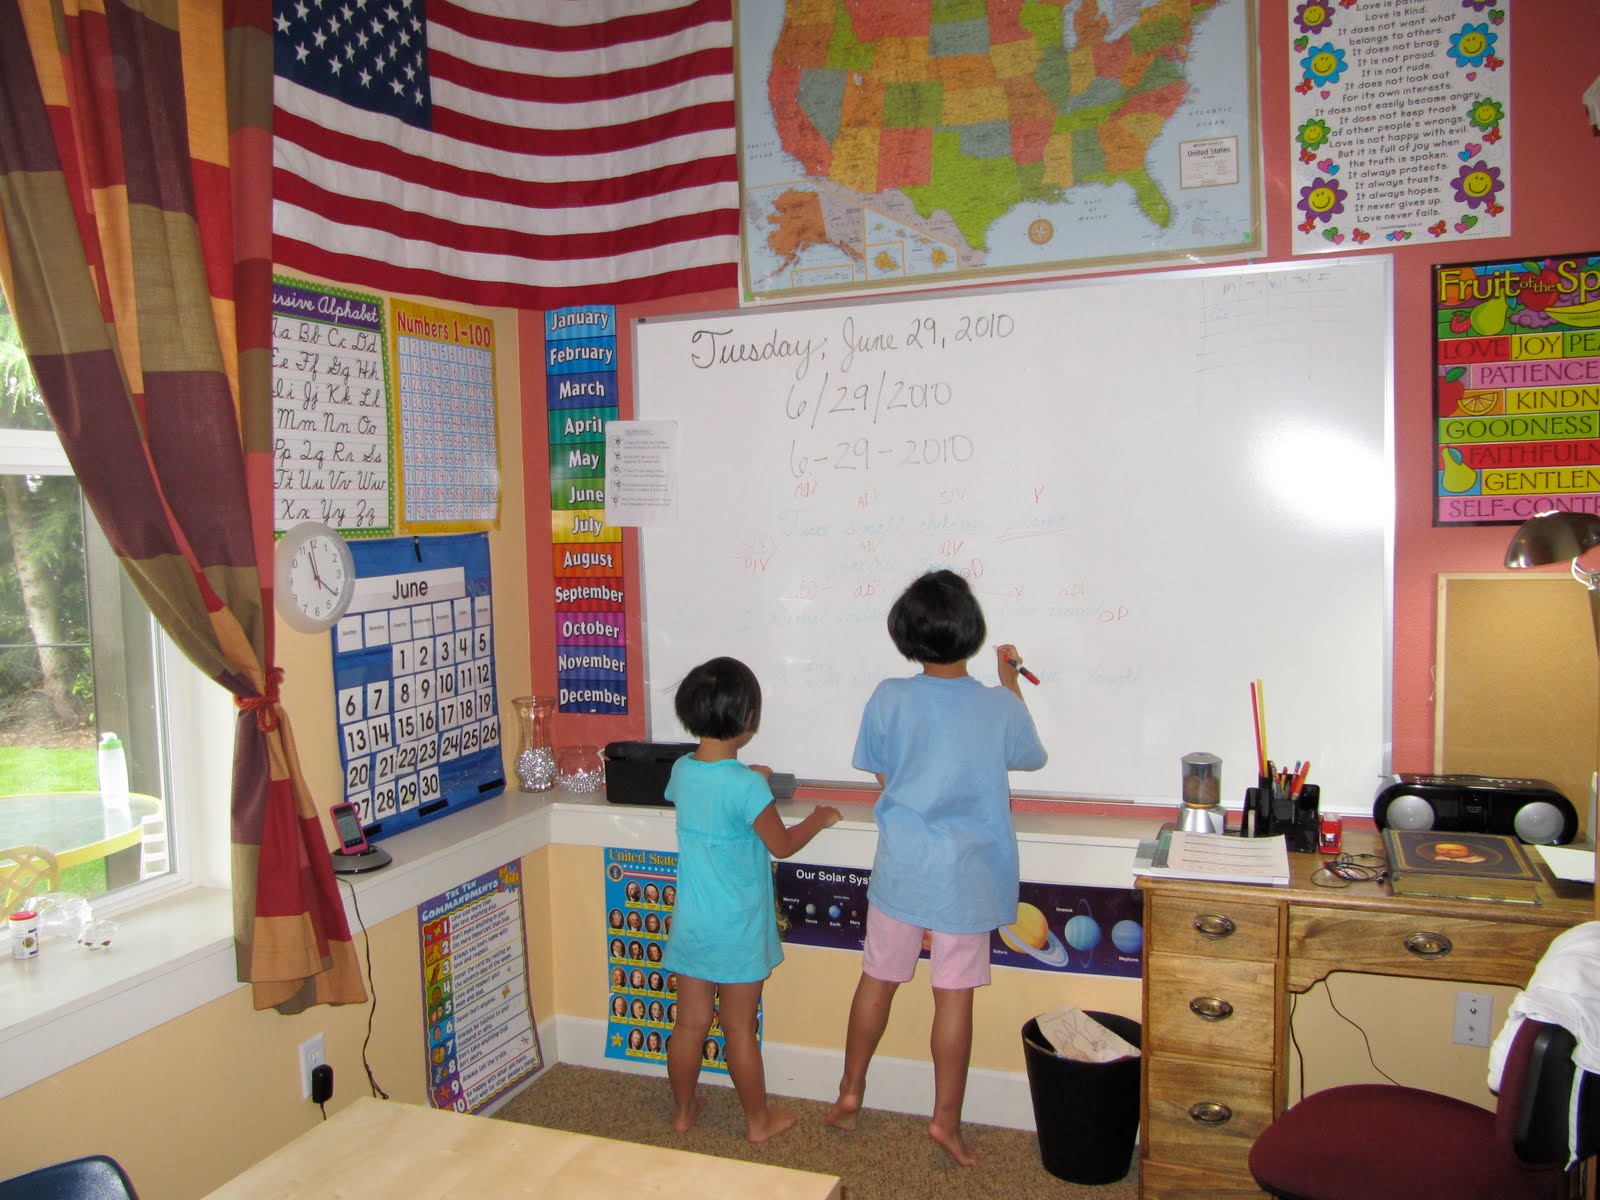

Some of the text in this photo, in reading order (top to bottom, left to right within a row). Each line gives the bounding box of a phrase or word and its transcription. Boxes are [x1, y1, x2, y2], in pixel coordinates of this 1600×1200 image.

[1351, 26, 1374, 34] does
[1400, 18, 1425, 27] want
[1430, 13, 1456, 23] what
[1365, 46, 1389, 54] does
[1393, 42, 1410, 50] not
[1407, 74, 1428, 83] look
[1346, 126, 1374, 134] other
[1378, 118, 1420, 132] people's
[1424, 117, 1465, 127] wrongs.
[1368, 157, 1393, 165] truth
[1410, 151, 1448, 160] spoken.
[1348, 163, 1448, 179] It always protects.
[1368, 180, 1403, 188] always
[1370, 190, 1404, 199] always
[1357, 214, 1381, 222] Love
[1440, 269, 1520, 302] Fruit
[1520, 276, 1535, 289] of
[1534, 278, 1556, 293] the
[318, 296, 378, 322] Alphabet
[397, 310, 490, 347] Numbers 1-100
[550, 311, 609, 331] January
[840, 316, 898, 372] June
[906, 318, 945, 349] 29,
[955, 314, 1015, 341] 2010
[1443, 337, 1507, 360] LOVE
[1514, 336, 1561, 360] JOY
[1570, 334, 1600, 352] PE
[550, 348, 613, 366] February
[1480, 362, 1599, 384] PATIENCE
[560, 381, 605, 399] March
[786, 371, 952, 429] 6/29/2010
[564, 416, 603, 436] April
[1446, 416, 1592, 439] GOODNESS
[569, 450, 599, 469] May
[568, 486, 604, 504] June
[572, 516, 602, 536] July
[325, 544, 327, 552] 1
[333, 554, 337, 562] 2
[563, 551, 613, 569] August
[392, 579, 429, 600] June
[556, 586, 624, 603] September
[315, 607, 319, 616] 6
[327, 600, 332, 609] 5
[563, 621, 619, 638] October
[400, 633, 486, 670] 1 2 3 4 5
[558, 655, 625, 672] November
[345, 664, 489, 716] 6 7 8 9 10 11 12
[560, 688, 626, 706] December
[348, 693, 491, 752] 13 14 15 16 17 18 19
[350, 722, 497, 788] 20 21 22 23 24 25 26
[377, 788, 395, 813] 28
[400, 781, 417, 806] 29
[422, 773, 438, 796] 30
[609, 849, 646, 863] United
[796, 869, 815, 879] Our
[819, 871, 846, 882] Solar
